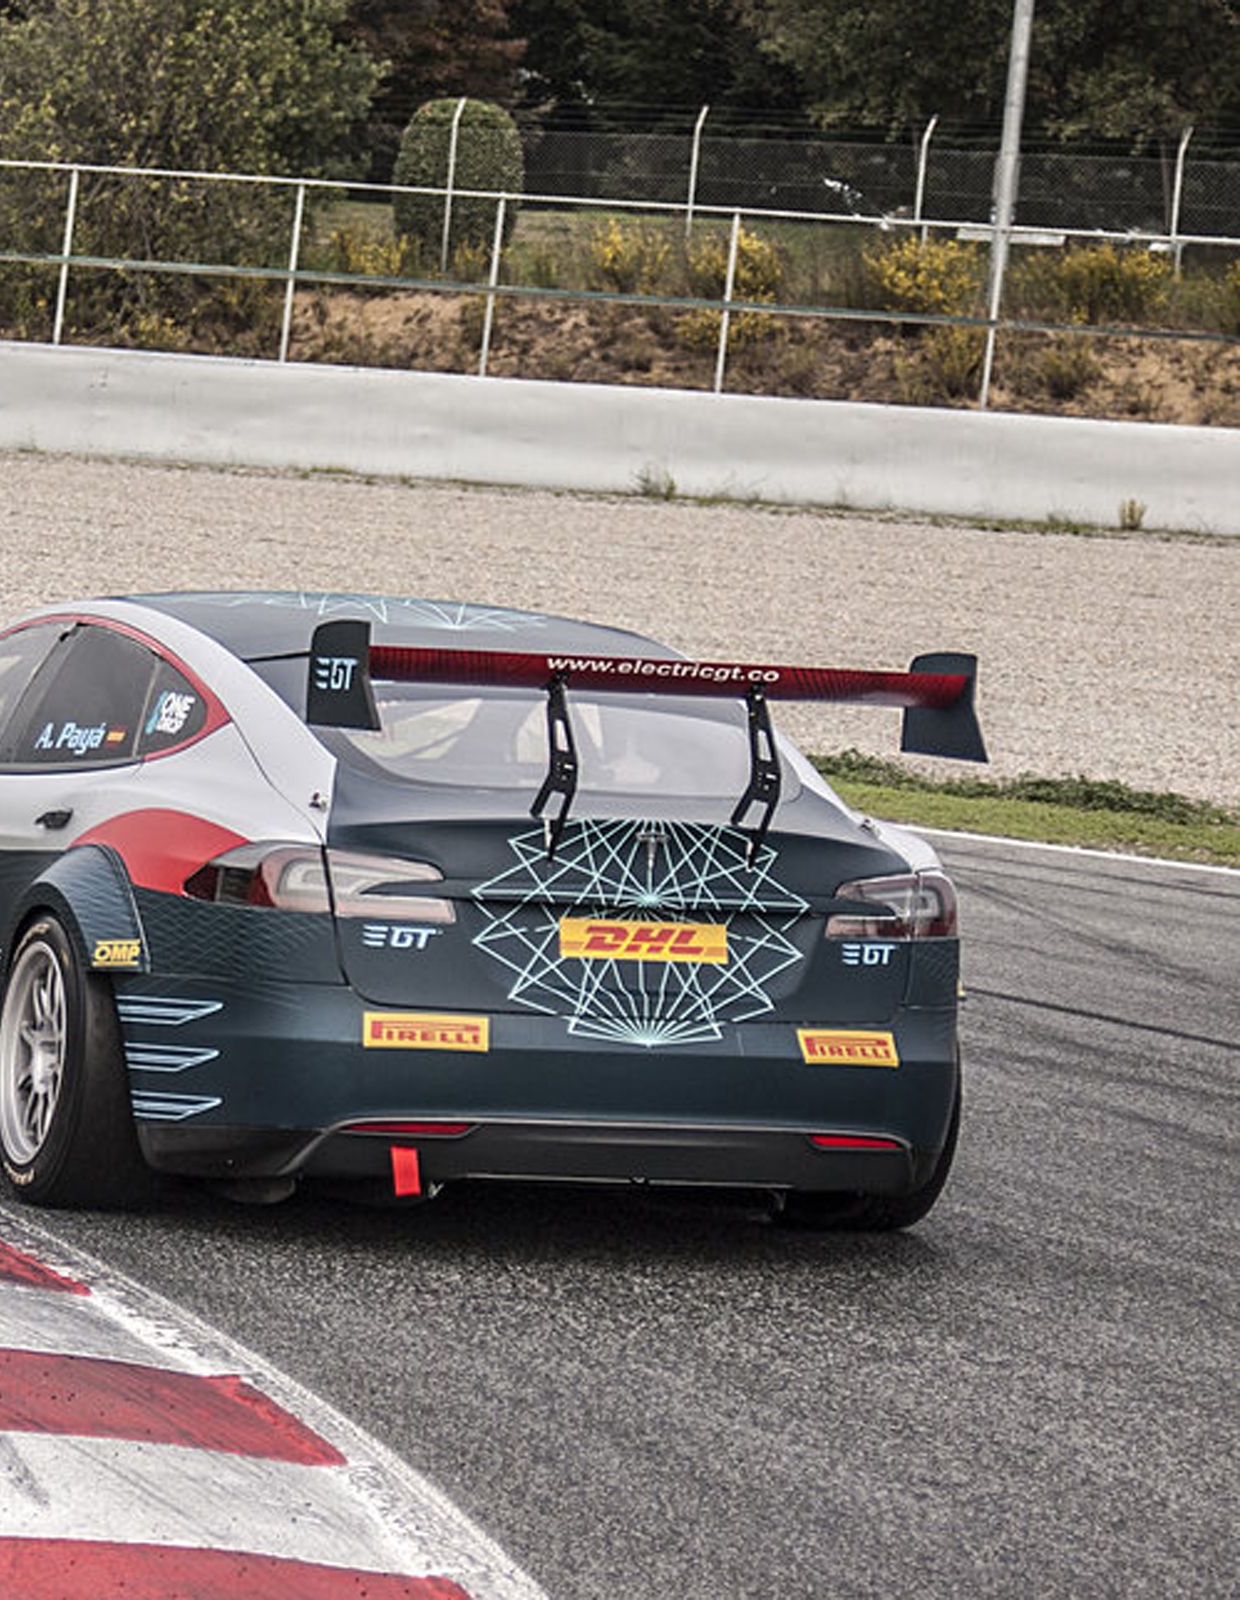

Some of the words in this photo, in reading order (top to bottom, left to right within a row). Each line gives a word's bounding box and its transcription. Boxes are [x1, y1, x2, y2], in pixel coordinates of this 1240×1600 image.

[547, 657, 780, 682] www.electricgt.co
[34, 722, 55, 749] A.
[56, 722, 106, 756] Payá
[584, 924, 704, 955] DHL
[93, 943, 141, 964] OMP
[370, 1020, 480, 1045] PIRELLI
[804, 1036, 892, 1059] PIRELLI
